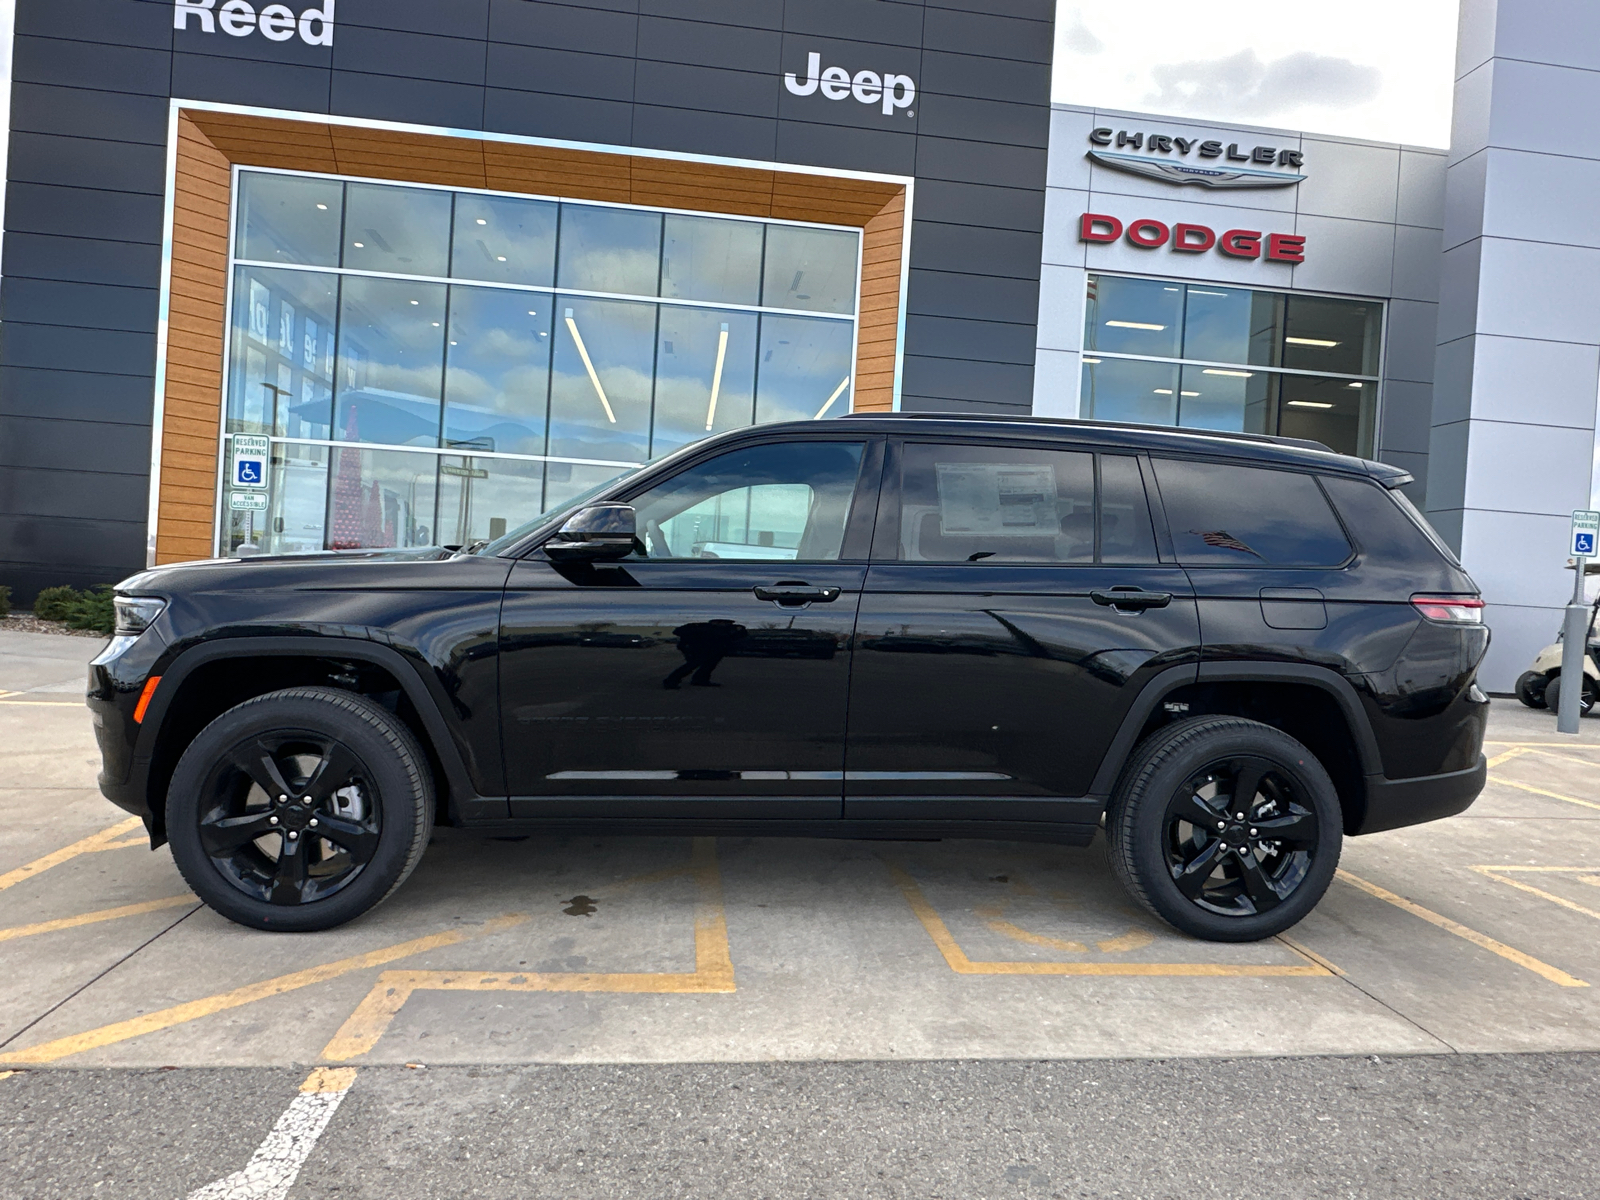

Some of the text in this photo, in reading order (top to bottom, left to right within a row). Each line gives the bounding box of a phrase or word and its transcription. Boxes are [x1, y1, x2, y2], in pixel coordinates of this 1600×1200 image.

[174, 0, 335, 46] Reed
[784, 52, 916, 115] Jeep
[1090, 127, 1304, 167] CHRYSLER
[1079, 212, 1306, 264] DODGE
[235, 438, 266, 447] RESERVED
[235, 447, 266, 456] PARKING
